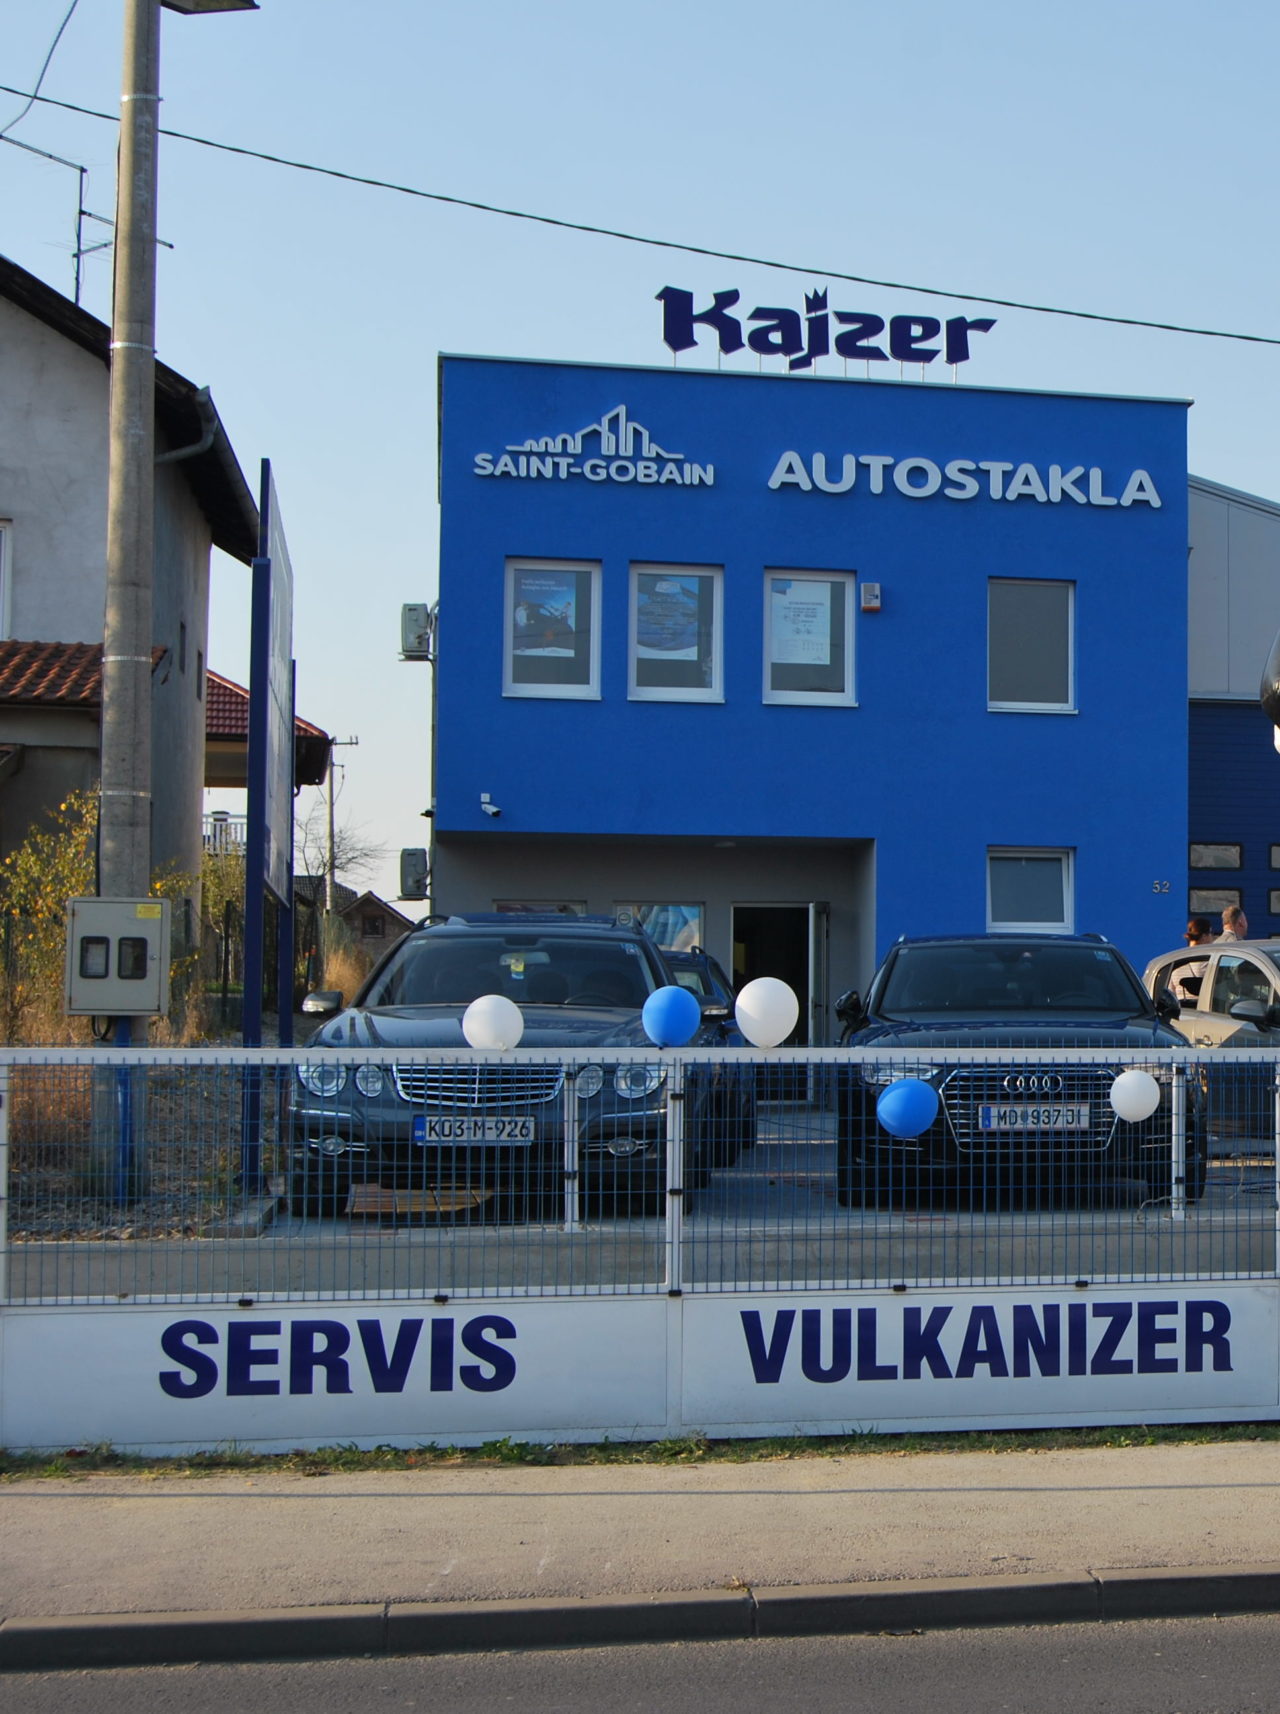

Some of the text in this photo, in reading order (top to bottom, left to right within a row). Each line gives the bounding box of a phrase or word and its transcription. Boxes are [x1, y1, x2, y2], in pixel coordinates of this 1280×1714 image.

[654, 284, 998, 371] Kajzer
[473, 452, 714, 486] SAINT-GOBAIN
[767, 450, 1162, 508] AUTOSTAKLA
[1152, 880, 1169, 893] 52
[158, 1315, 517, 1399] SERVIS
[740, 1300, 1234, 1384] VULKANIZER
